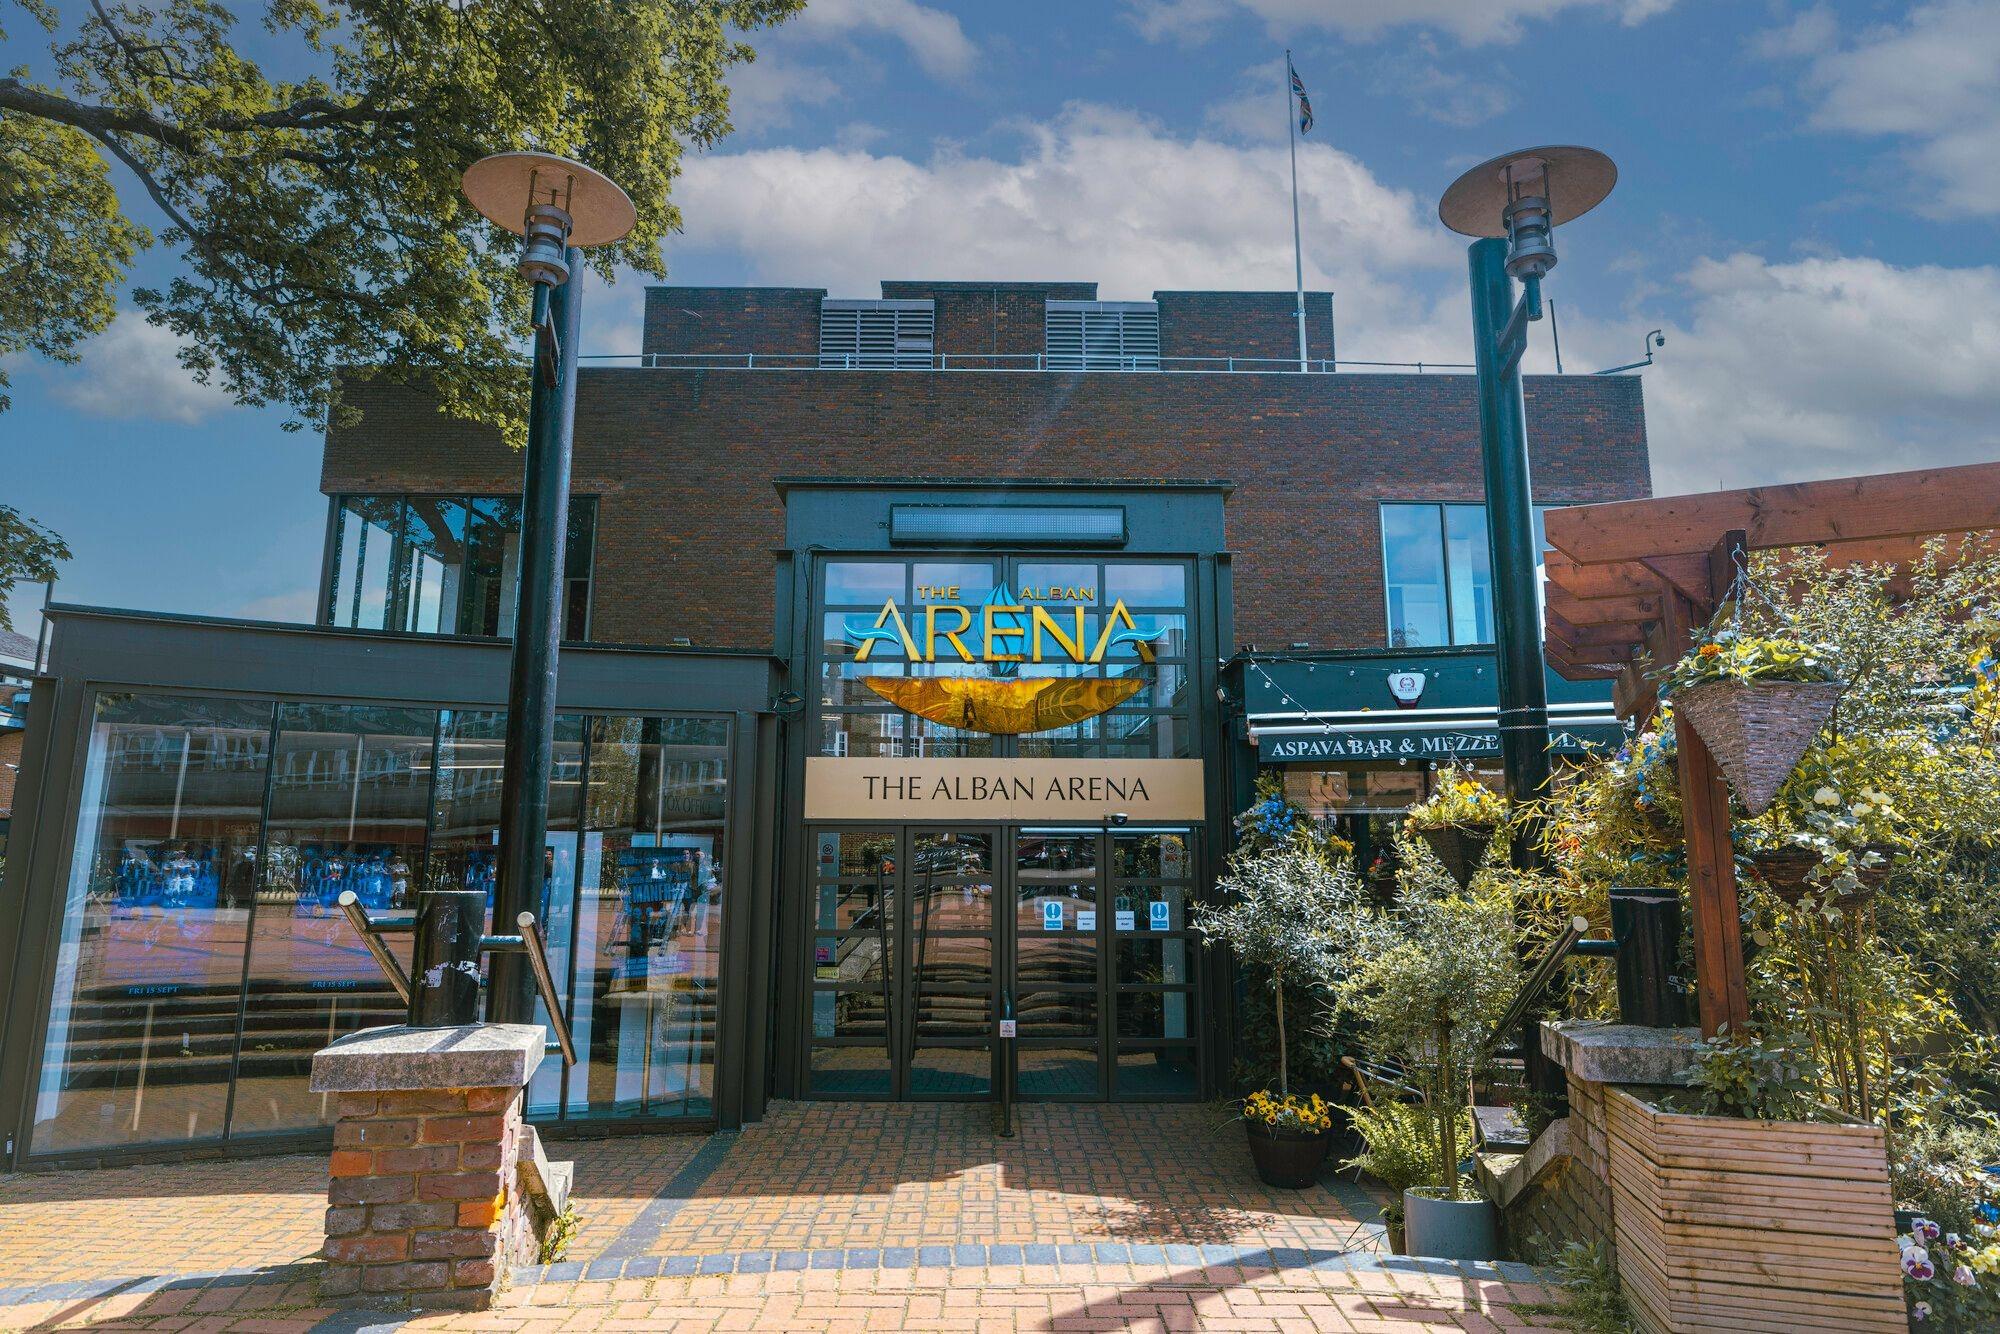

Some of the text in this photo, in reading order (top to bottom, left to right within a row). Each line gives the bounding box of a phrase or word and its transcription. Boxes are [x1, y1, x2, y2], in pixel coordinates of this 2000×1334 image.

[917, 585, 1096, 601] THE ALBAN
[853, 595, 1158, 664] ARENA
[1271, 735, 1499, 757] ASPAVA BAR & MEZZE
[862, 776, 1151, 802] THE ALBAN ARENA
